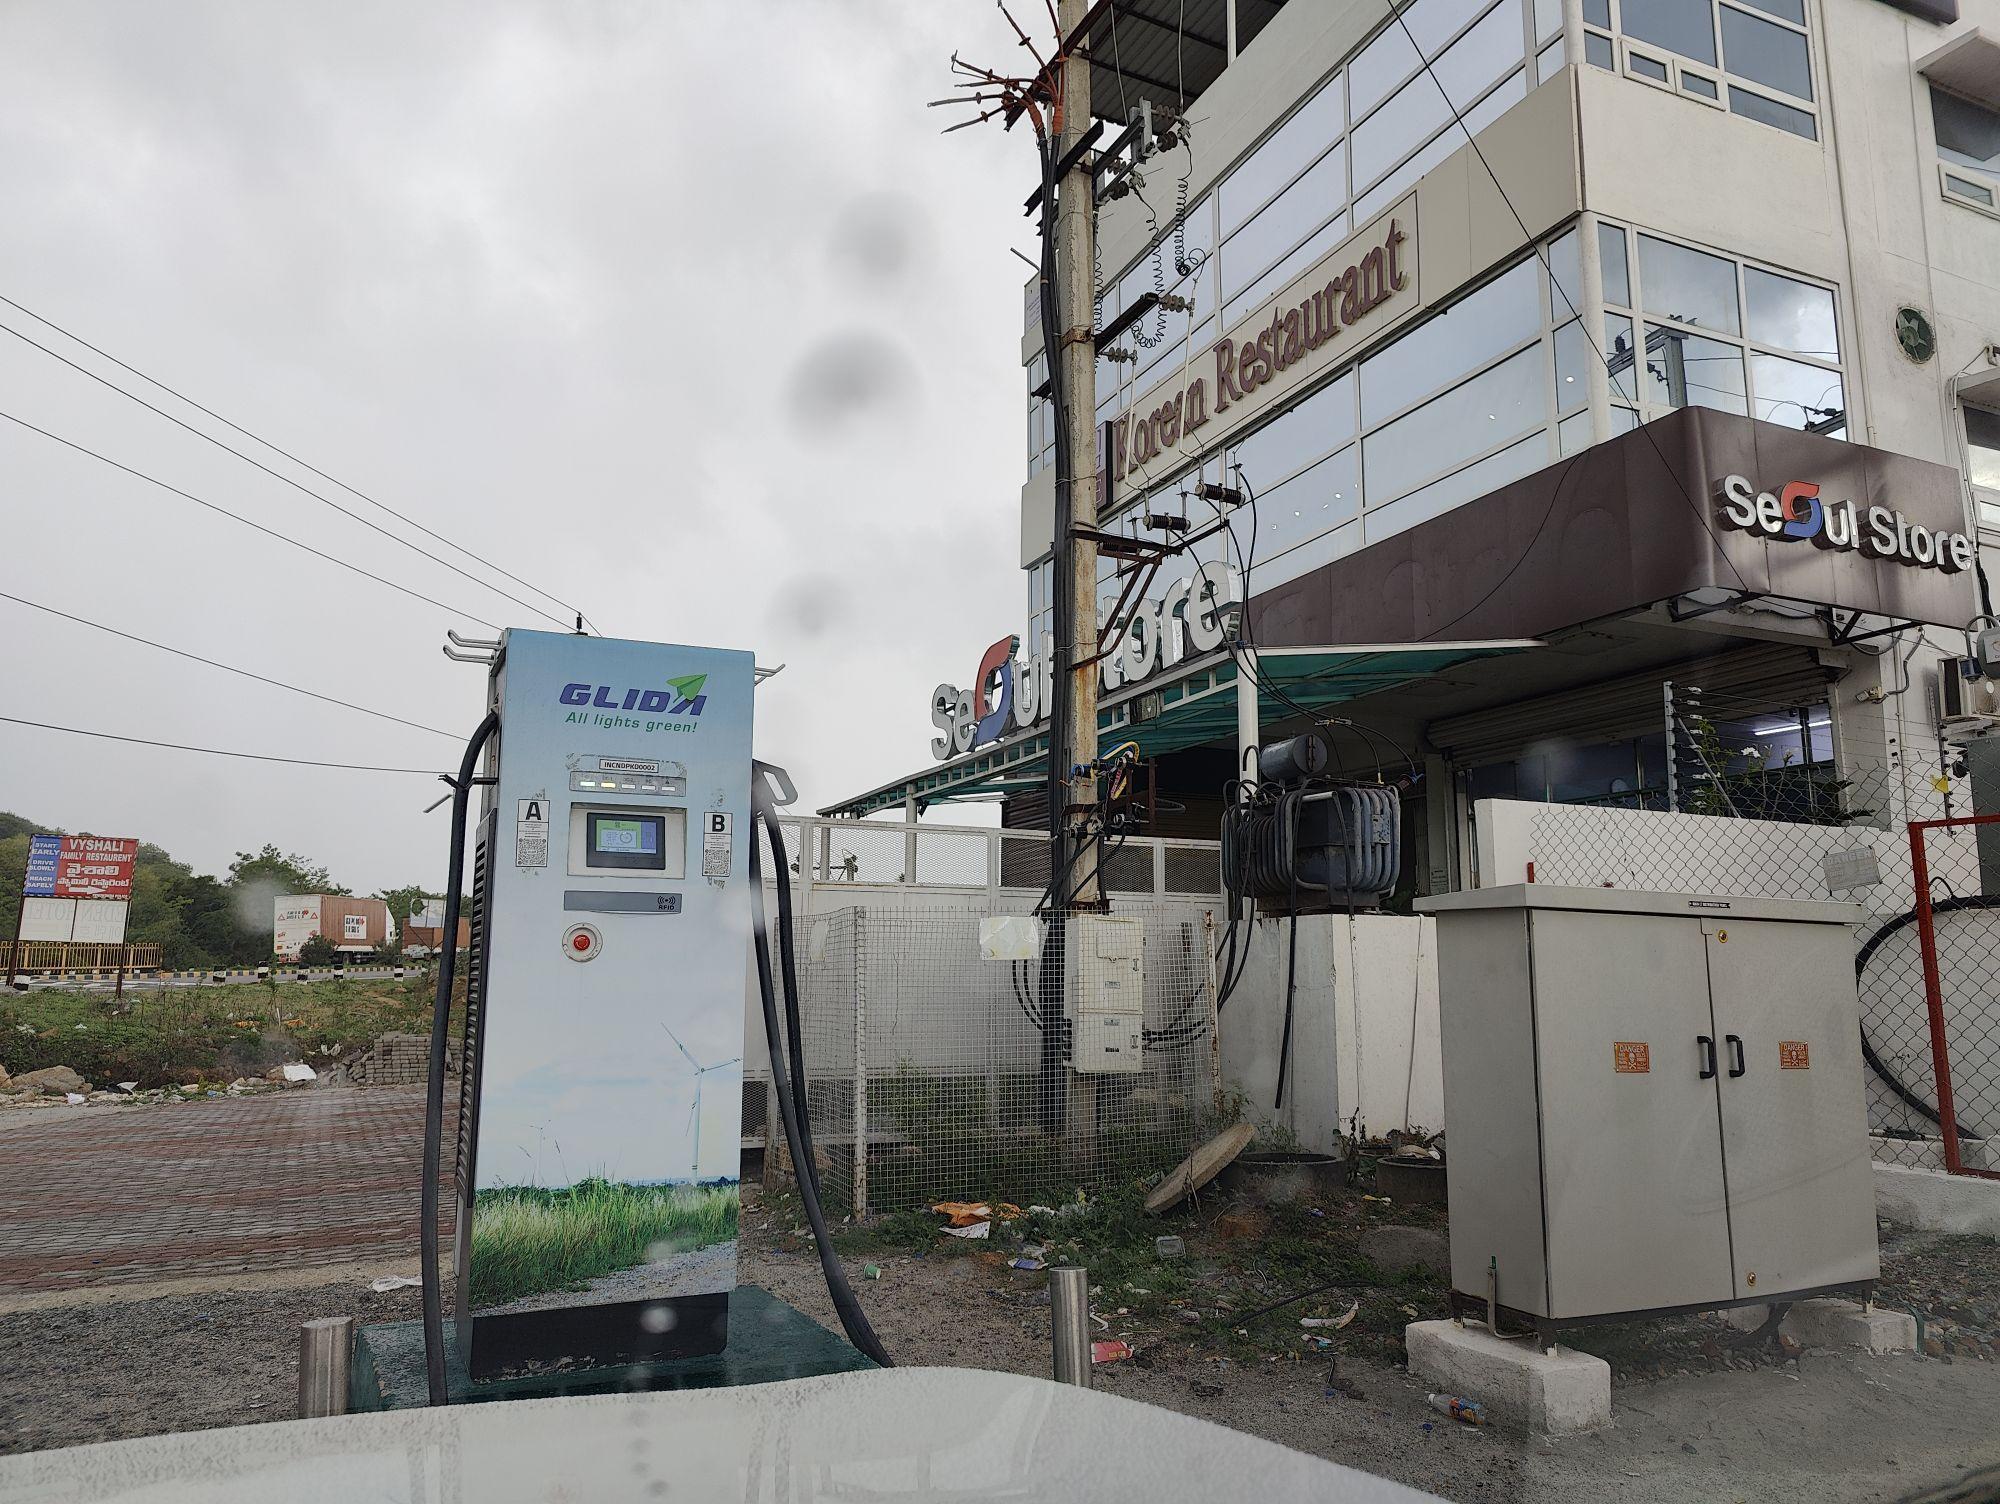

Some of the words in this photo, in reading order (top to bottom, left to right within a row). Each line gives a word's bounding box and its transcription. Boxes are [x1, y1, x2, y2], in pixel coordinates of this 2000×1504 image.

[1113, 377, 1211, 483] Korean
[1213, 218, 1407, 414] Restaurant
[1722, 473, 1860, 549] Seoul
[1869, 504, 1973, 572] Store
[1098, 560, 1243, 691] tore
[559, 682, 708, 716] GLIDA
[565, 711, 589, 724] All
[594, 714, 641, 729] lights
[646, 721, 698, 733] green!
[525, 801, 542, 821] A
[711, 813, 726, 833] B
[69, 838, 124, 852] VYSHALI
[60, 851, 83, 860] FAMILY
[86, 852, 133, 863] RESTAURENT
[1783, 1043, 1805, 1051] DANGER
